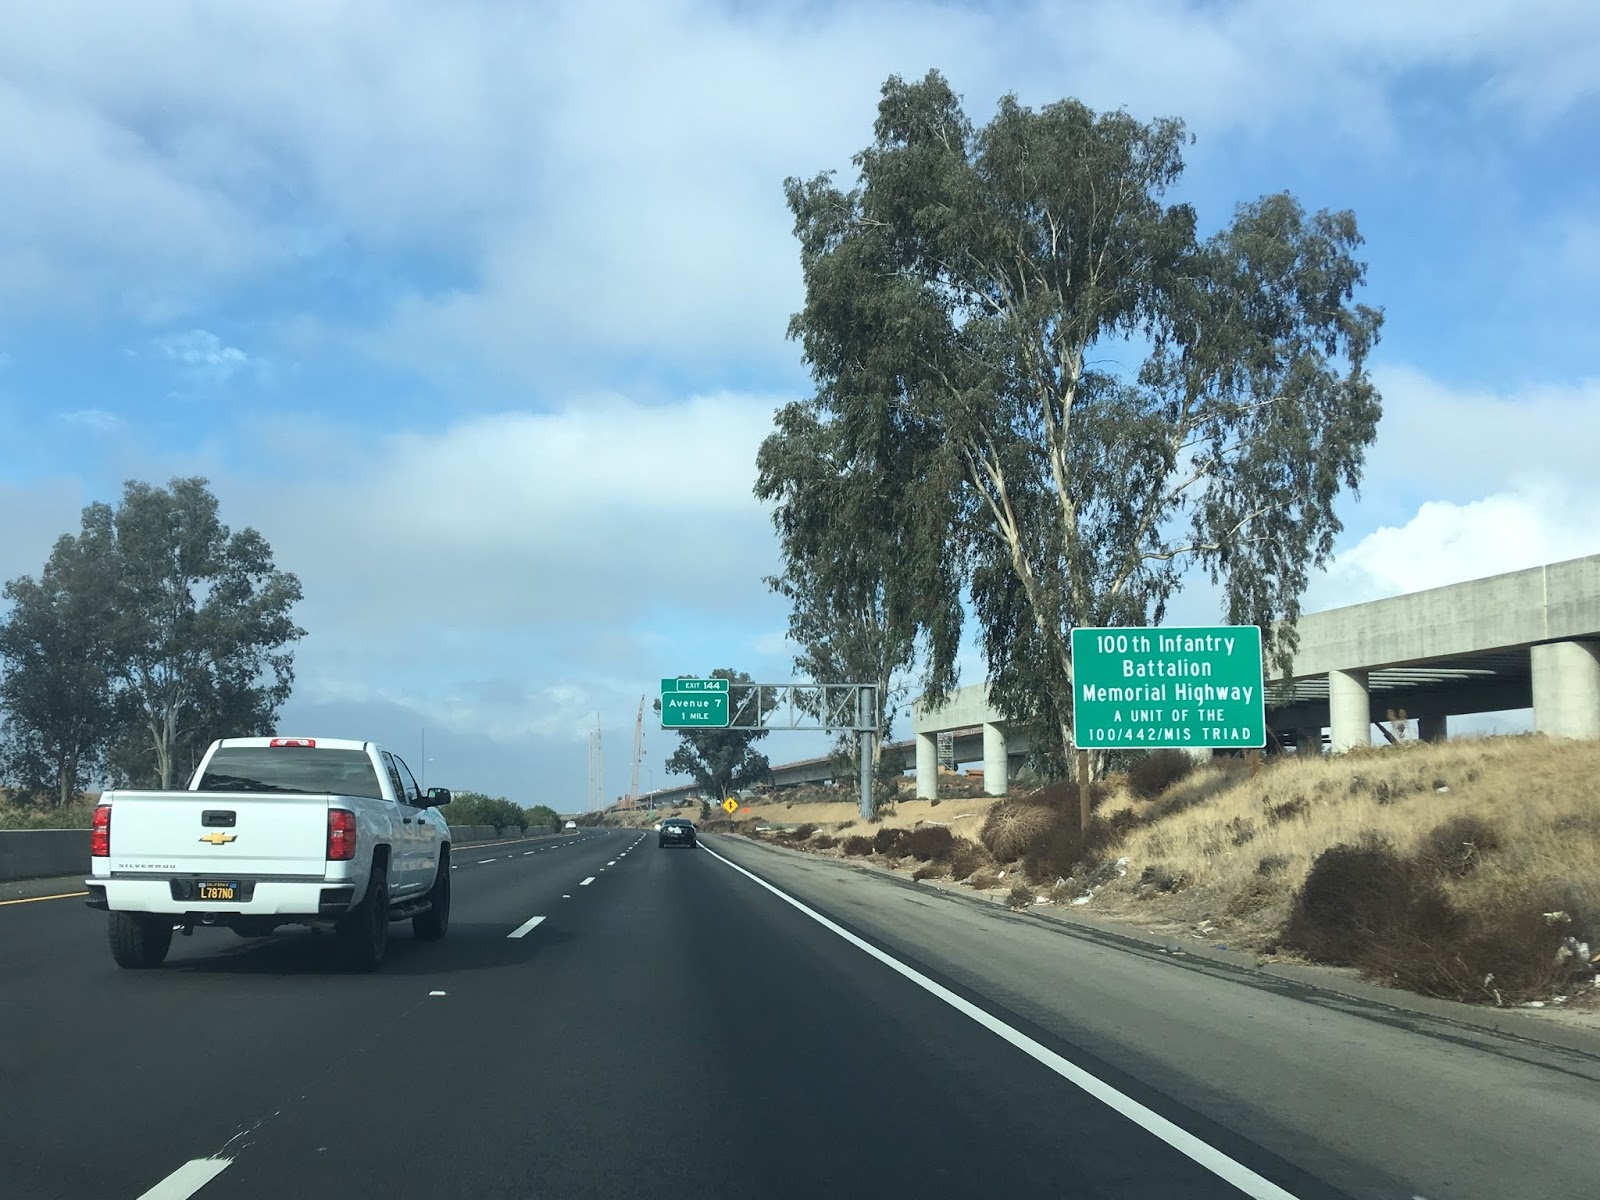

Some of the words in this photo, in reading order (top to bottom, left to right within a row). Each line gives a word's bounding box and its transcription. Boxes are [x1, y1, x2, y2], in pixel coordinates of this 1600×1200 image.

[1097, 635, 1150, 653] 100th
[1159, 634, 1235, 656] Infantry
[1122, 659, 1212, 678] Battalion
[703, 681, 720, 690] 144
[1082, 684, 1167, 702] Memorial
[1175, 683, 1253, 706] Highway
[668, 699, 709, 708] Avenue
[714, 699, 722, 708] 7
[681, 712, 686, 720] 1
[690, 712, 710, 720] MILE
[1113, 709, 1122, 722] A
[1130, 709, 1163, 722] UNIT
[1171, 709, 1189, 722] OF
[1198, 708, 1225, 722] THE
[1088, 727, 1192, 741] 100/442/MIS
[1202, 727, 1251, 740] TRIAD
